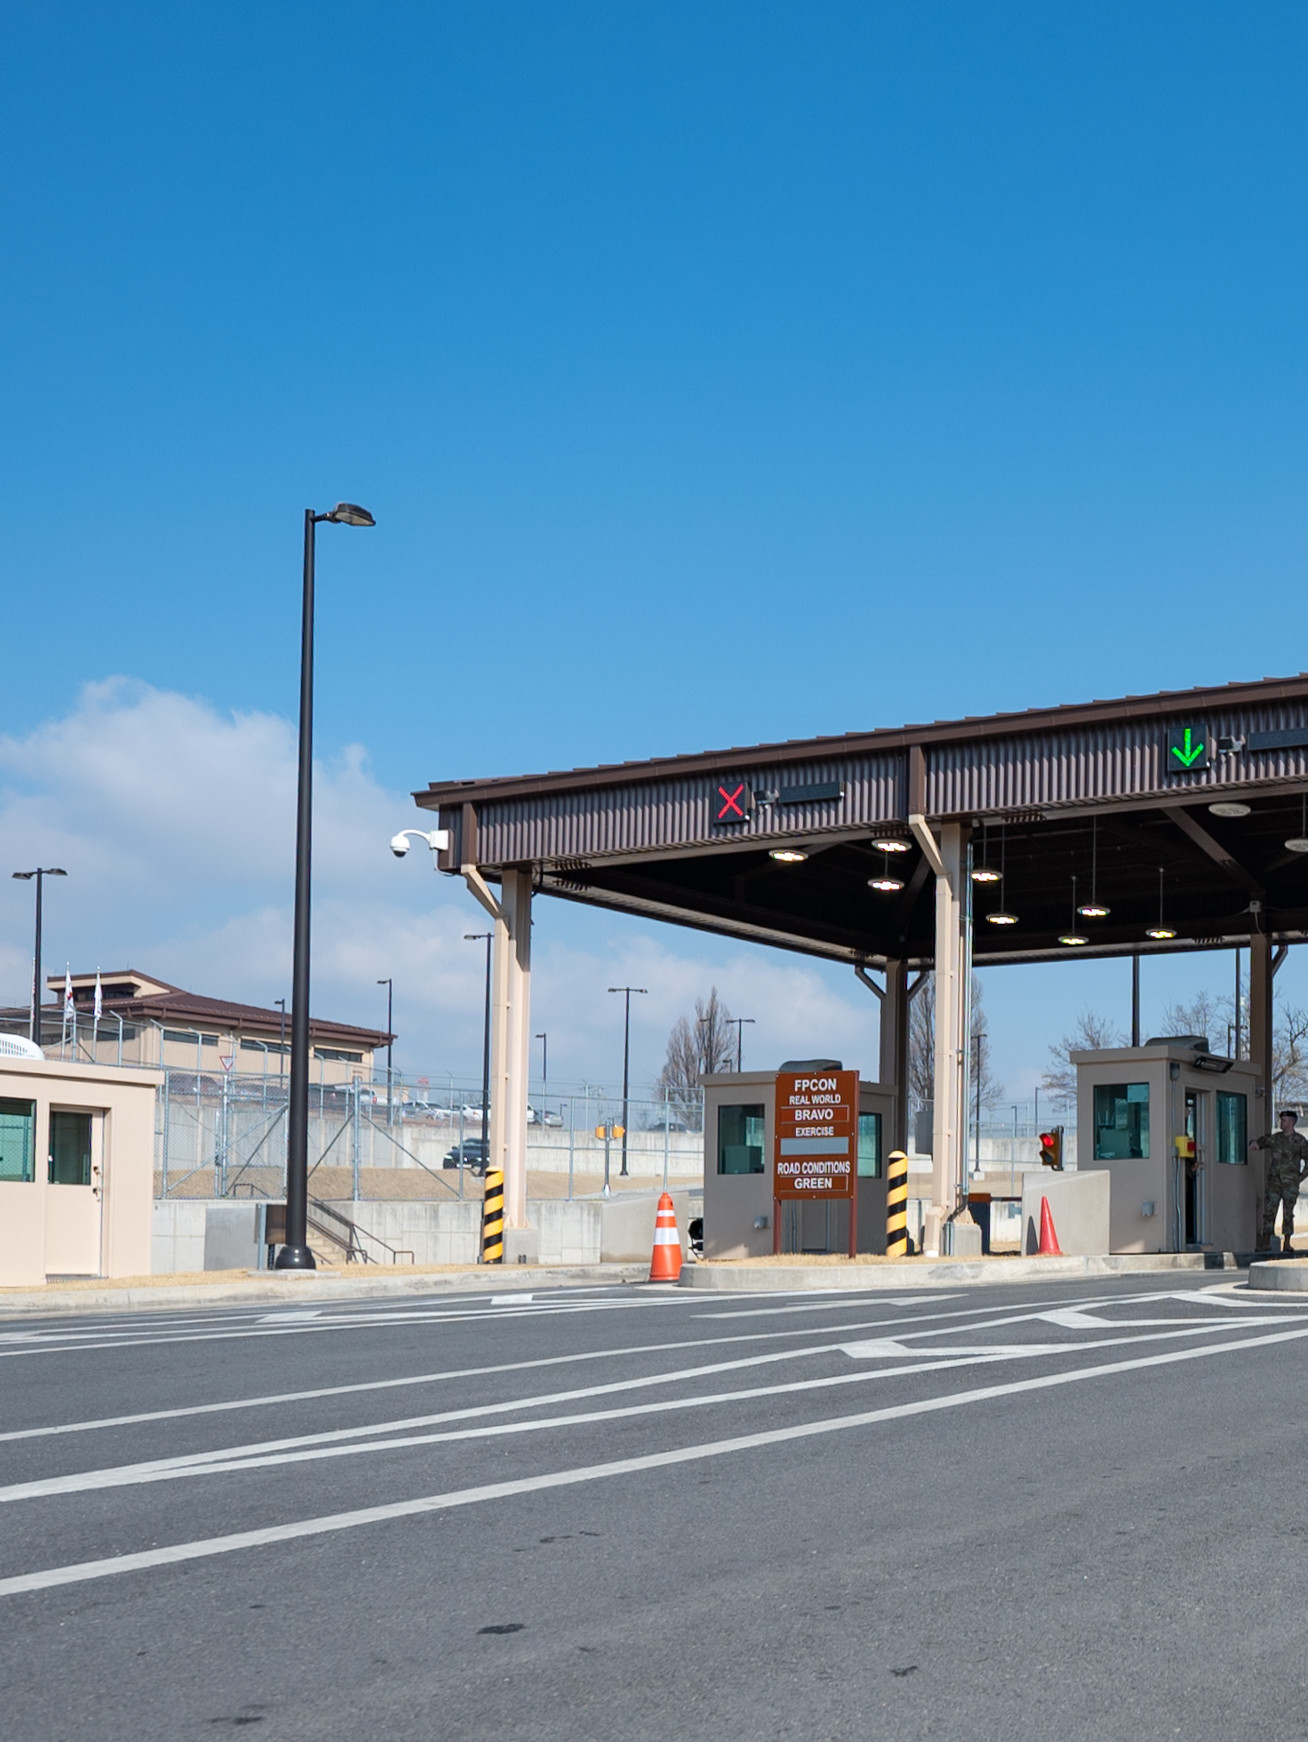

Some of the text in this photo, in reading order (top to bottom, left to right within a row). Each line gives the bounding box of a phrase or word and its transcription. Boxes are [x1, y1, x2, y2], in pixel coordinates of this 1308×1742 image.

[794, 1078, 837, 1092] FPCON
[789, 1094, 842, 1105] REAL WORLD
[794, 1108, 834, 1121] BRAVO
[795, 1126, 834, 1137] EXERCISE
[777, 1160, 851, 1175] ROAD CONDITIONS
[793, 1177, 833, 1189] GREEN
